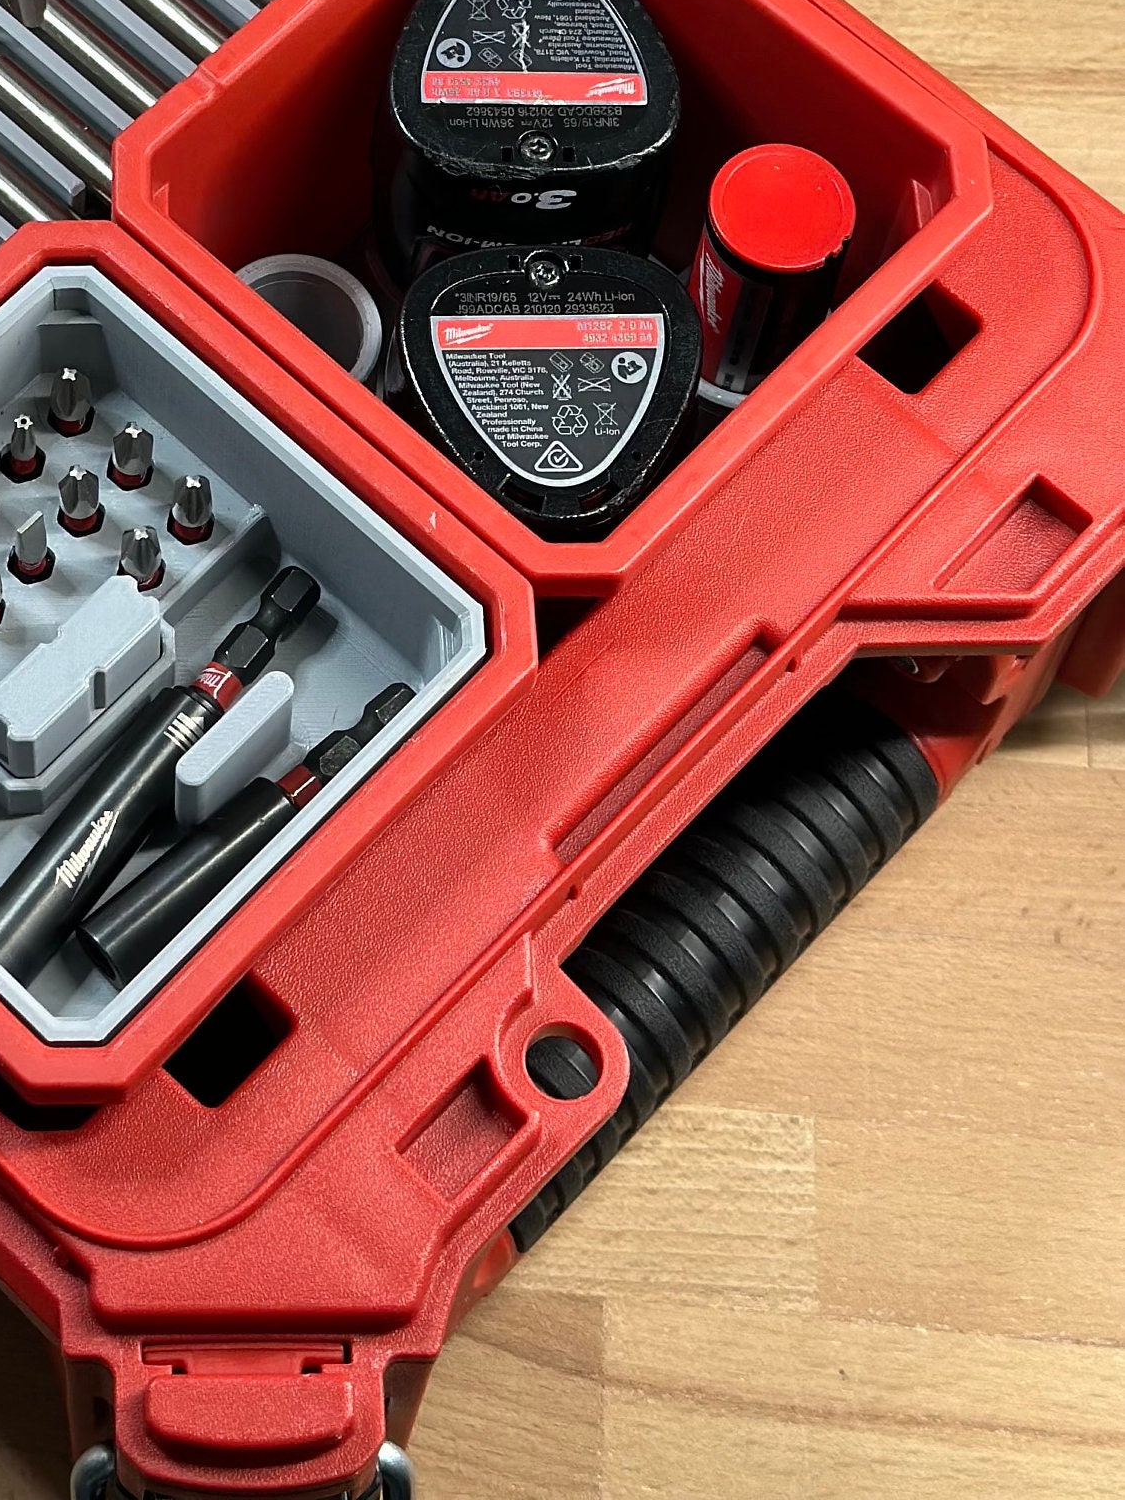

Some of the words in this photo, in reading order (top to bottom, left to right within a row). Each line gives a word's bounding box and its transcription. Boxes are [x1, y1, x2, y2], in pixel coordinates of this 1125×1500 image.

[585, 82, 636, 97] Milwaukee
[511, 190, 577, 210] 3.0
[567, 293, 601, 302] 24Wh
[524, 305, 561, 314] 210120
[565, 304, 614, 313] 2933623
[444, 323, 493, 341] Milwaukee
[55, 810, 113, 888] Milwaukee
